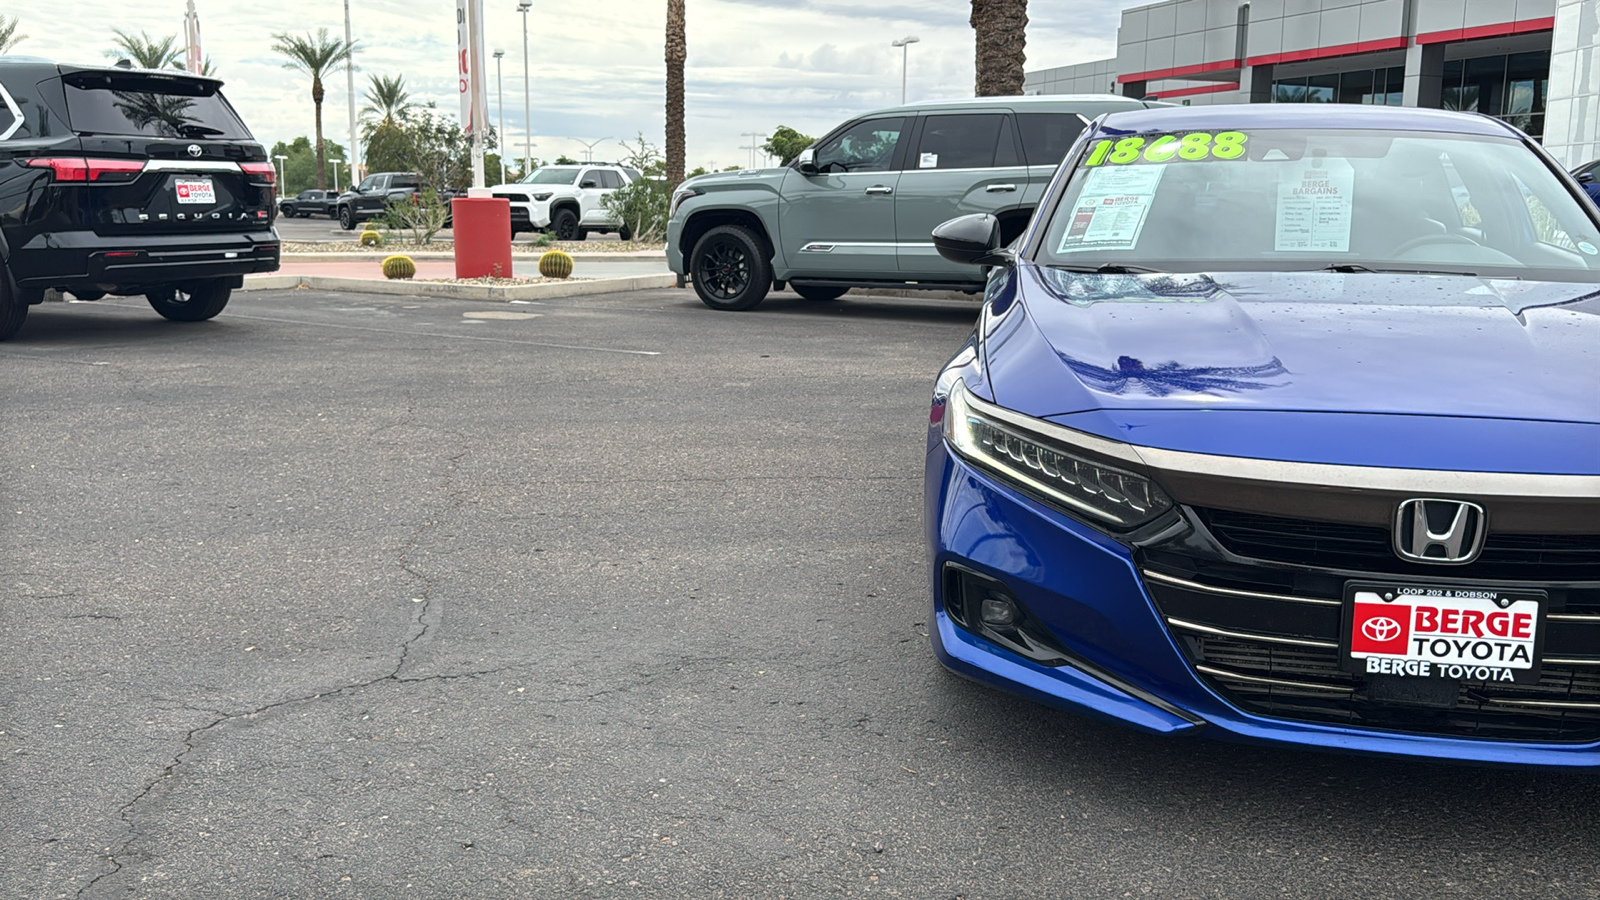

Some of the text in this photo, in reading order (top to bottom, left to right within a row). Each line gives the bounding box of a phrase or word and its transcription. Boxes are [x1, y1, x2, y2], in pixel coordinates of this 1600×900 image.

[1085, 131, 1248, 166] 18688
[189, 184, 211, 193] BERGE
[1301, 180, 1330, 188] BERGE
[1292, 187, 1338, 195] BARGAINS
[138, 212, 249, 222] SEQUOIA
[1397, 587, 1424, 596] LOOP
[1426, 589, 1442, 597] 202
[1455, 590, 1498, 600] DOBSON
[1414, 606, 1533, 639] BERGE
[1413, 637, 1531, 664] TOYOTA
[1366, 656, 1515, 683] BERGE TOYOTA
